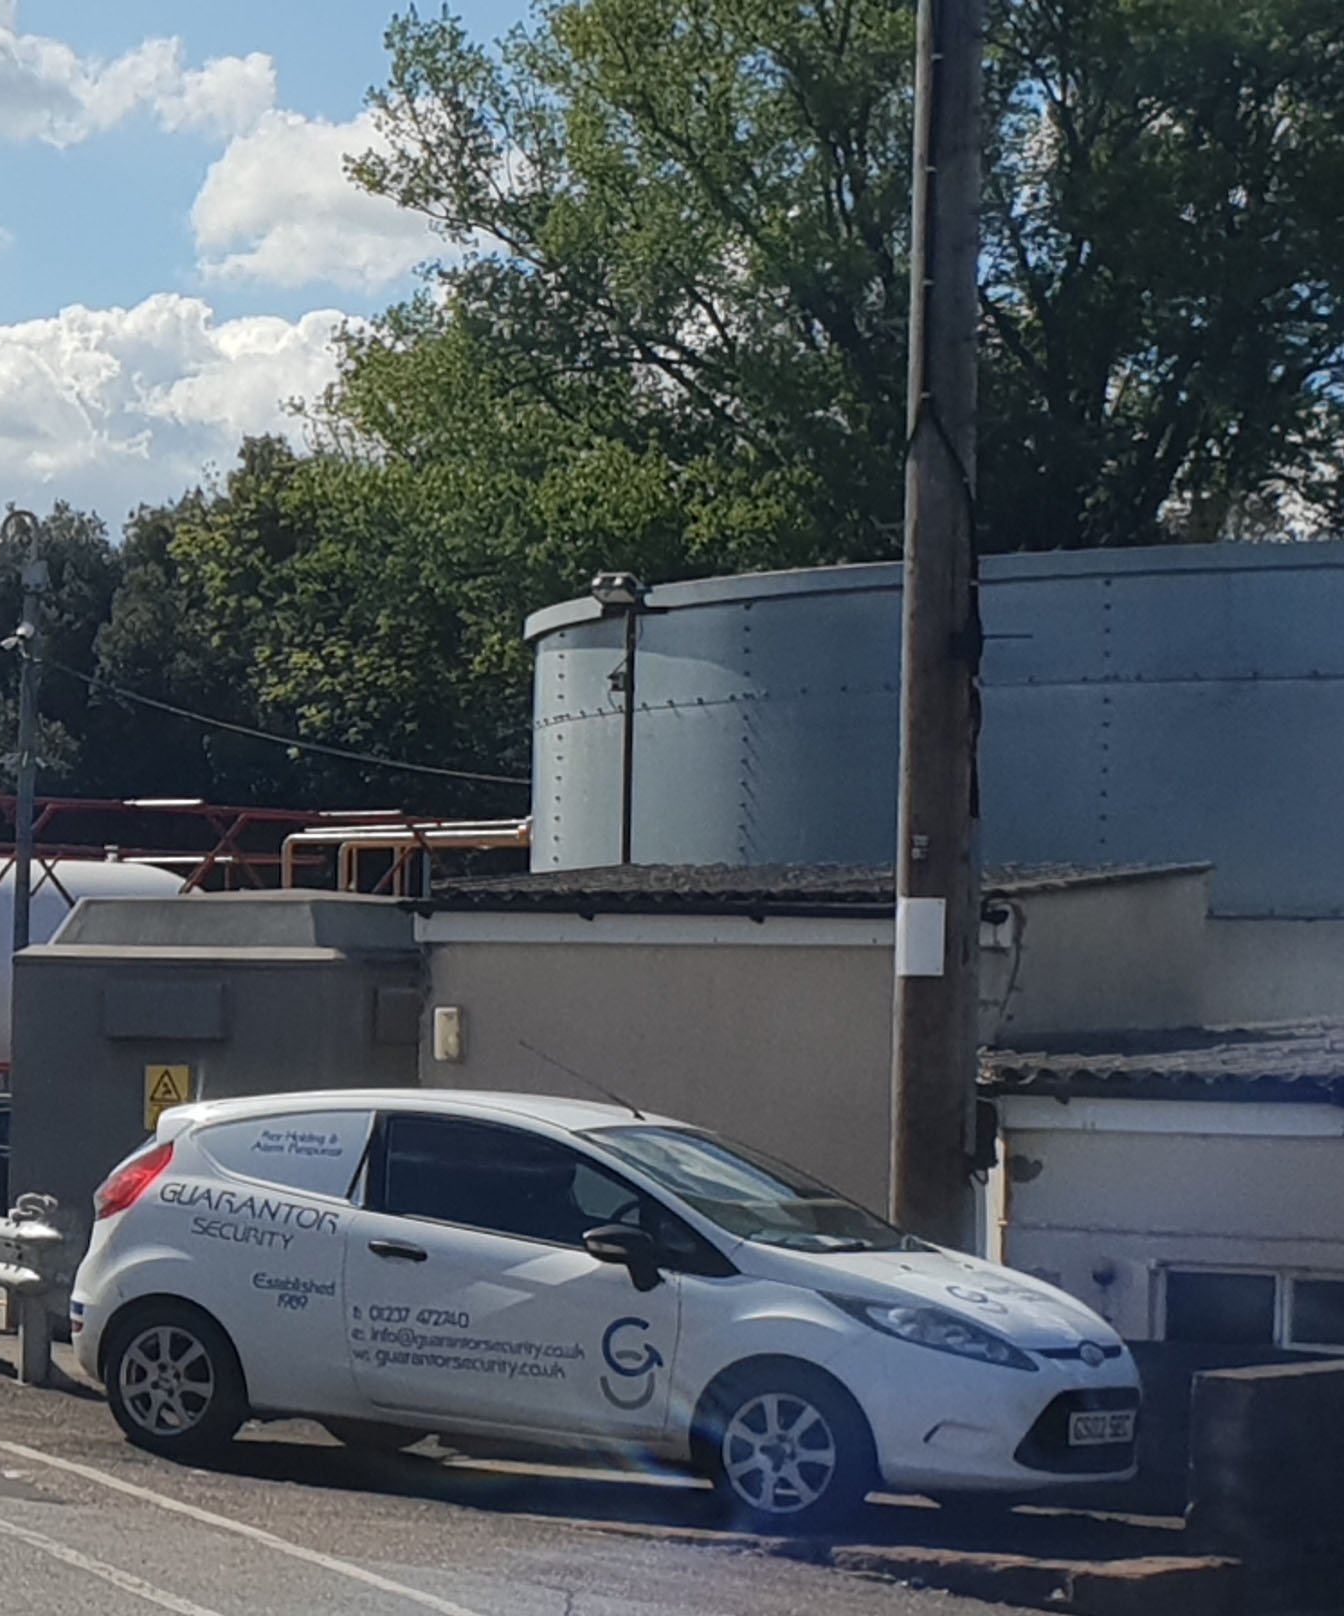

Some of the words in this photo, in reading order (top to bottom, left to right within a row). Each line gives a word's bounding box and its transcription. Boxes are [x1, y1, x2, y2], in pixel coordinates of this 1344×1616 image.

[160, 1182, 340, 1235] GUARANTOR
[191, 1216, 295, 1250] SECURITY
[252, 1272, 336, 1297] Established
[369, 1305, 411, 1323] 01237
[371, 1327, 585, 1360] info@guarantorsecurity.co.uk
[375, 1349, 566, 1379] guarantorsecurity.co.uk
